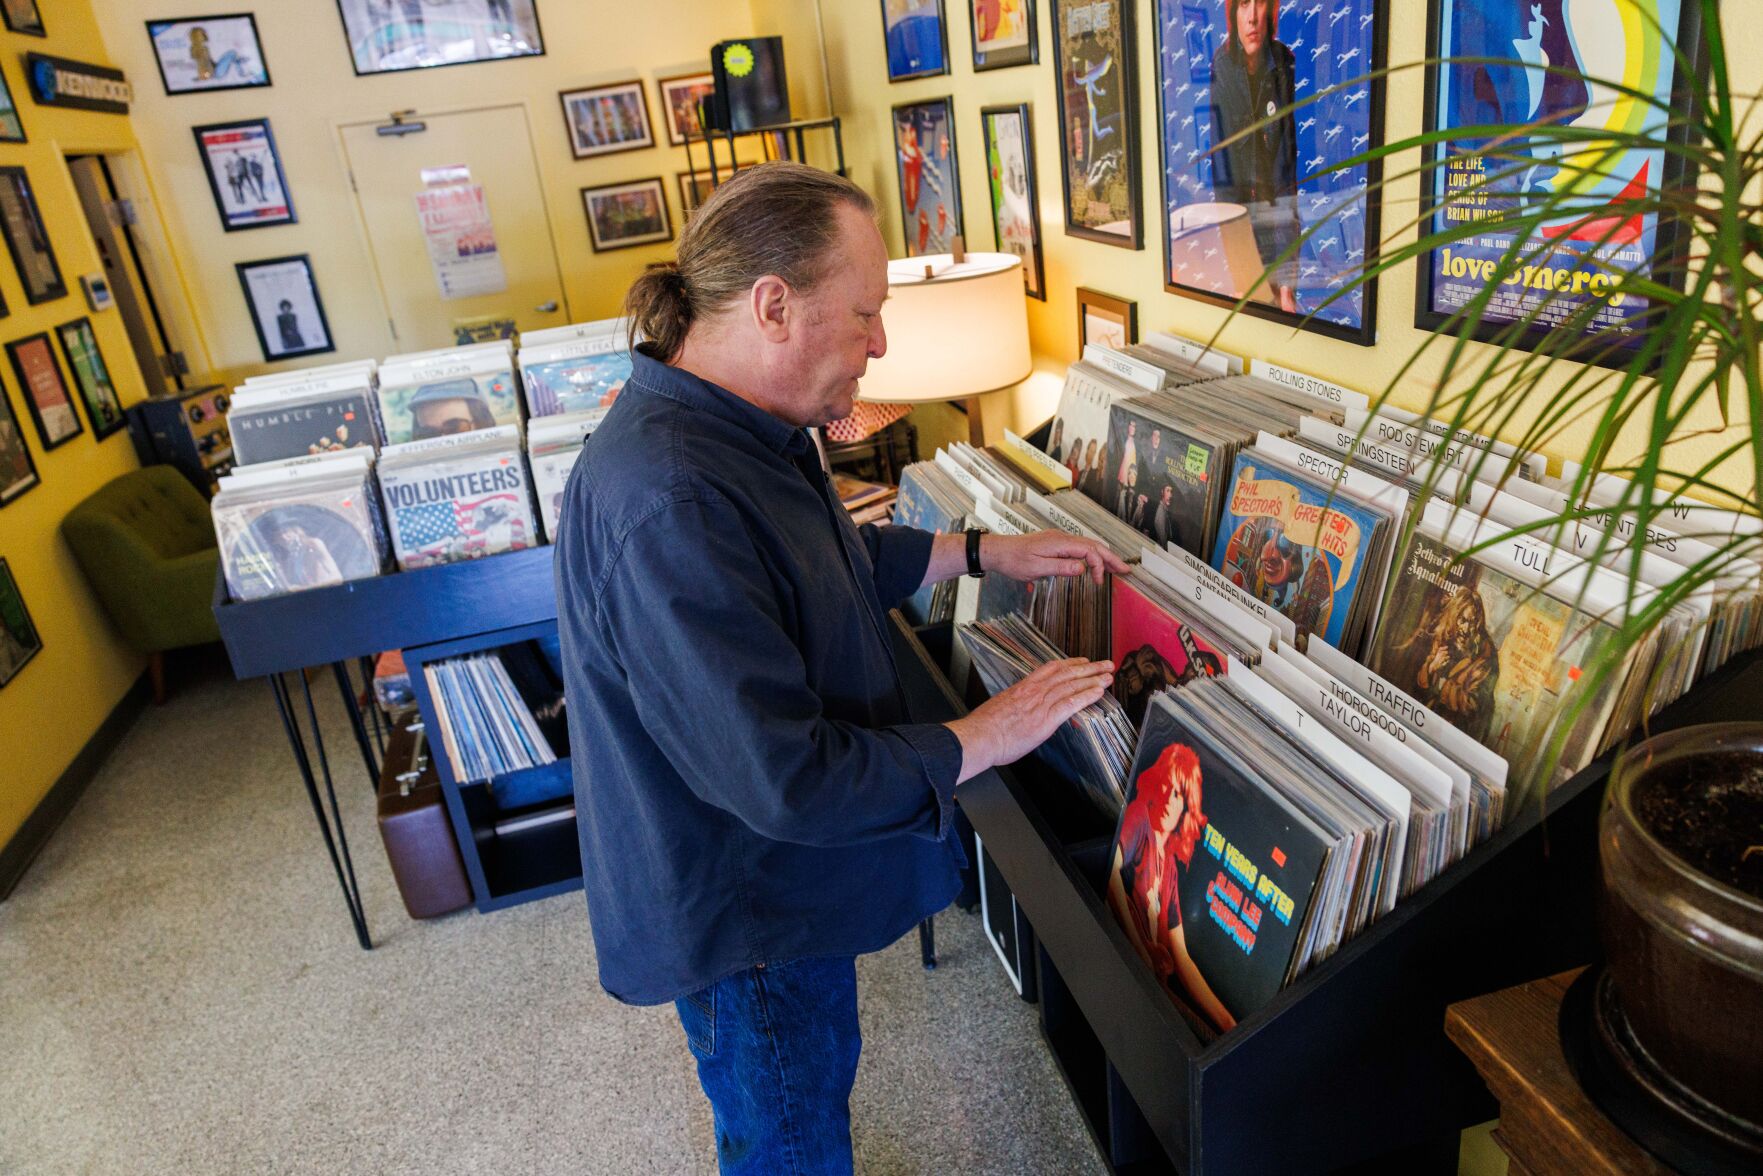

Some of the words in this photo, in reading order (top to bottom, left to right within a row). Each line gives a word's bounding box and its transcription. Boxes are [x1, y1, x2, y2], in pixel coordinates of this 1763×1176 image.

[56, 69, 135, 104] KENWOOD
[1448, 173, 1468, 187] LOVE
[1470, 174, 1487, 187] AND
[1466, 157, 1485, 173] LIFE,
[1477, 191, 1489, 205] OF
[1447, 207, 1470, 221] BRIAN
[1473, 209, 1504, 223] WILSON
[1269, 367, 1305, 389] ROLLING
[1306, 380, 1342, 402] STONES
[241, 410, 313, 431] HUMBLE
[326, 402, 355, 416] PIE
[1378, 422, 1403, 443] ROD
[1404, 432, 1465, 465] STEWRT
[1297, 452, 1349, 485] SPECTOR
[385, 466, 521, 509] VOLUNTEERS
[1238, 481, 1259, 496] PHIL
[1231, 496, 1283, 517] SPECTOR'S
[1673, 501, 1691, 521] W
[1049, 507, 1084, 537] RUNDGREN
[1595, 511, 1677, 553] VENTRES
[1321, 532, 1348, 557] HITS
[1576, 531, 1587, 549] V
[1513, 543, 1551, 576] TULL
[1195, 586, 1202, 601] S
[1319, 690, 1372, 742] TAYLOR
[1330, 680, 1407, 743] THOROGOOD
[1367, 676, 1426, 728] TRAFFIC
[1296, 710, 1304, 728] T
[1203, 823, 1226, 861] TEN
[1224, 842, 1258, 891] YEARS
[1256, 874, 1295, 927] AFTER
[1241, 896, 1262, 932] LEE
